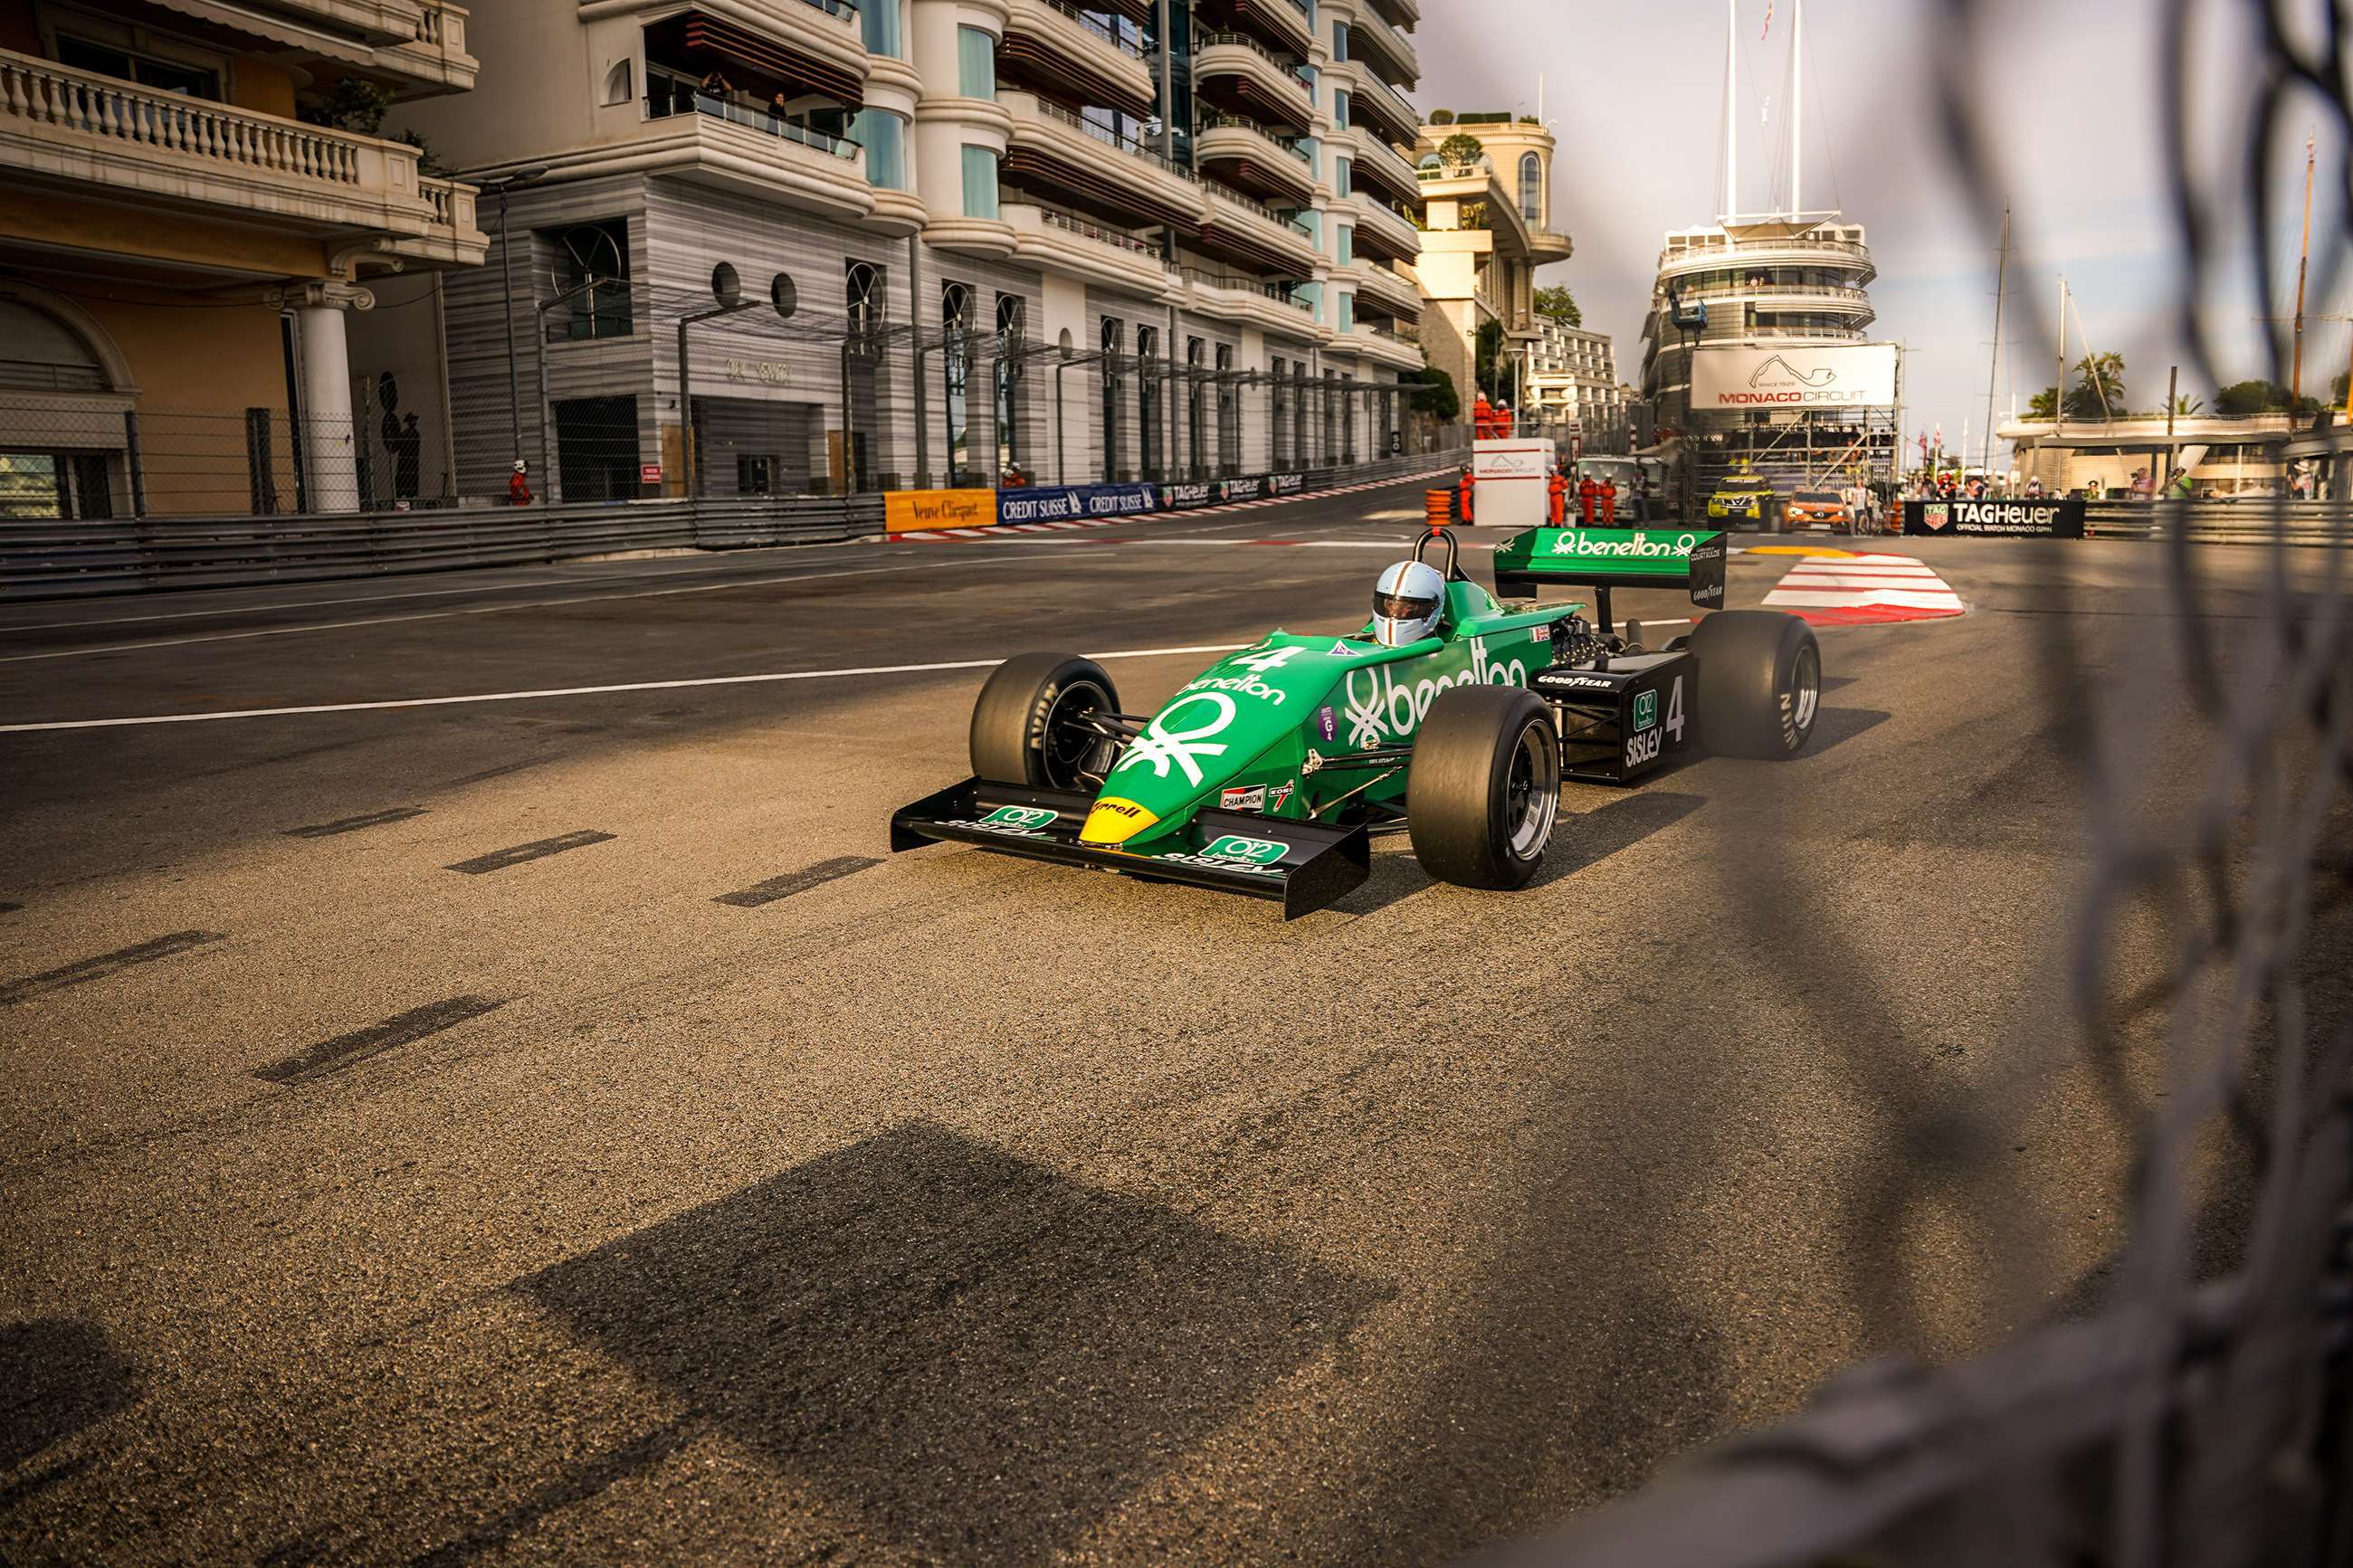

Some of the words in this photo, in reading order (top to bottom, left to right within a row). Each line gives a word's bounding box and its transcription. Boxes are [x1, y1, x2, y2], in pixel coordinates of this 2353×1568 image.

[913, 501, 939, 519] Veuve
[941, 500, 978, 521] Clicquot
[1003, 500, 1037, 520] CREDIT
[1038, 498, 1068, 517] SUISSE
[1090, 495, 1119, 514] CREDIT
[1119, 494, 1142, 510] SUISSE
[1984, 524, 2005, 532] WATCH
[1577, 531, 1672, 556] benetton
[1229, 645, 1308, 672] 4
[1538, 675, 1612, 689] GOODYEAR
[1666, 675, 1685, 743] 4
[1625, 727, 1663, 768] SISLEY
[1224, 794, 1262, 808] CHAMPION
